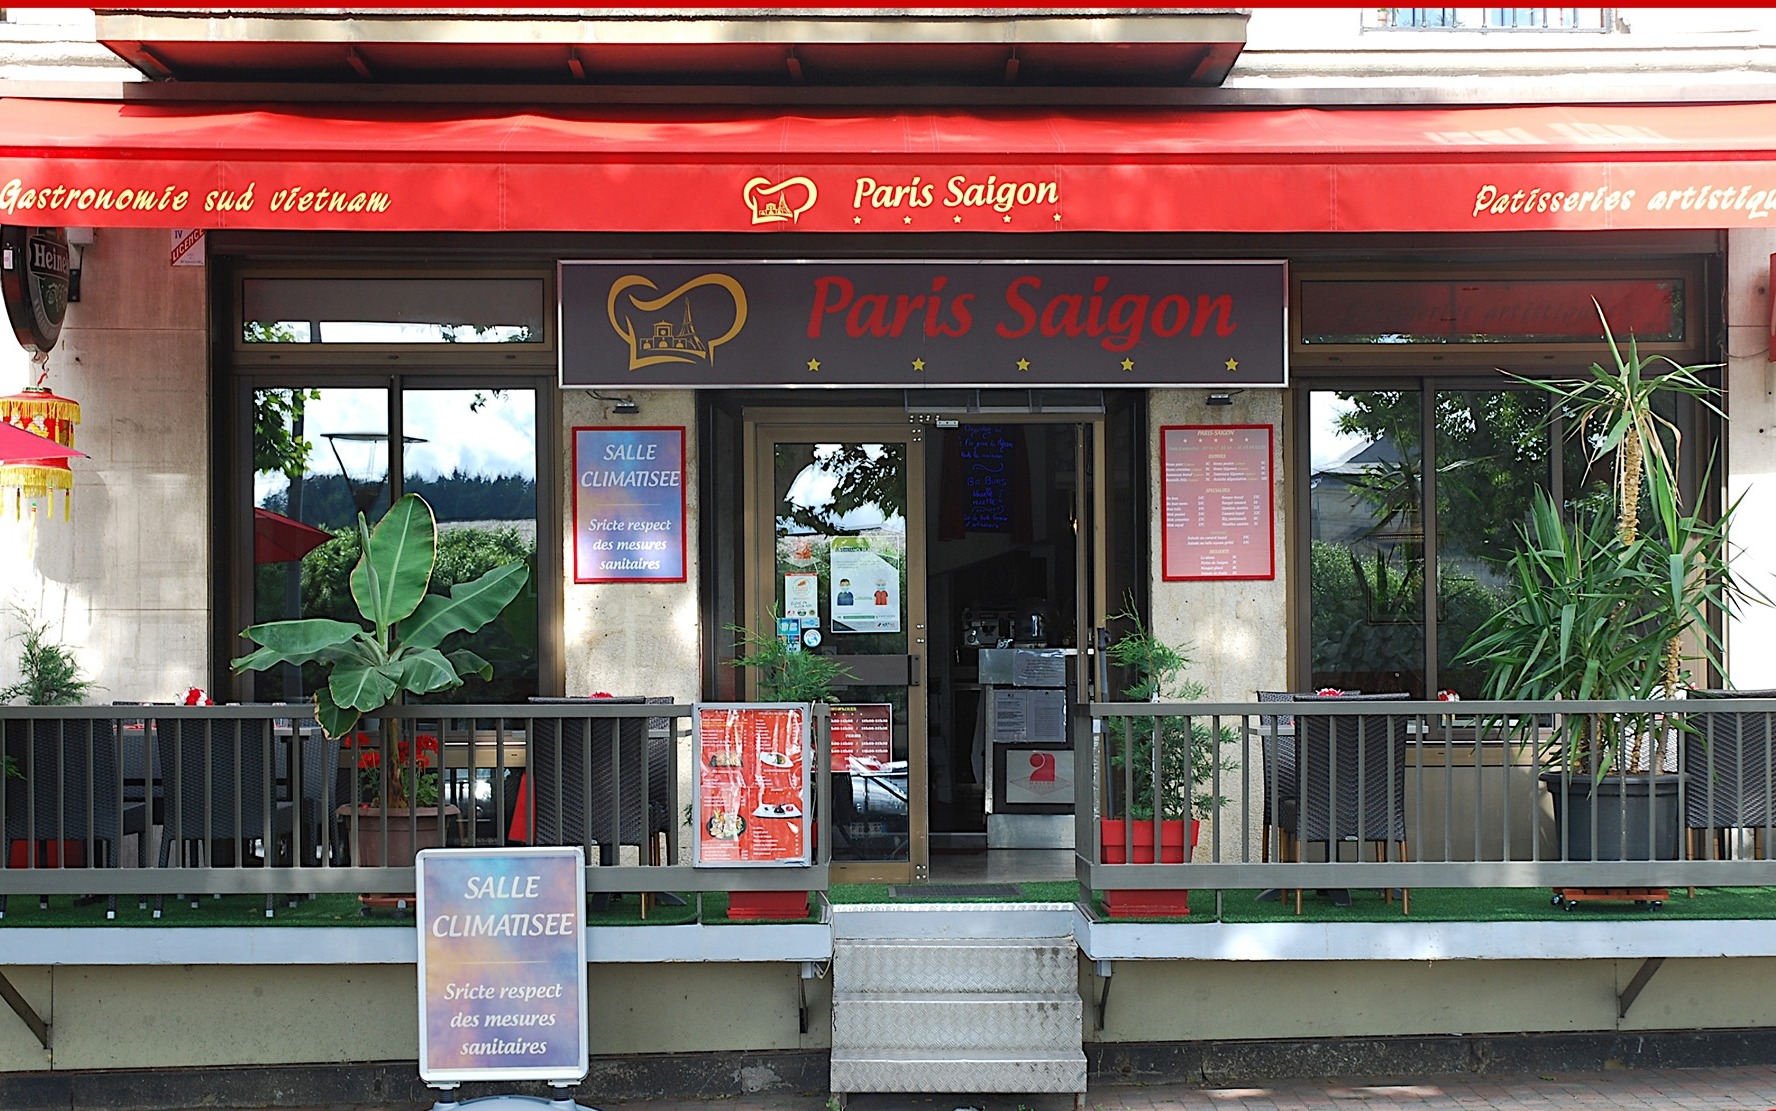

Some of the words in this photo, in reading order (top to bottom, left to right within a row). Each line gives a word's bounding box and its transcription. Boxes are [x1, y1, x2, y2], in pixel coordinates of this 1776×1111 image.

[0, 179, 189, 214] Gastronomie
[204, 181, 255, 212] sud
[269, 186, 391, 214] vietnam
[853, 176, 934, 208] Paris
[943, 175, 1059, 212] Saigon
[1472, 184, 1636, 217] Patisseries
[34, 243, 68, 274] Heine
[806, 275, 975, 338] Paris
[996, 275, 1238, 353] Saigon
[603, 444, 657, 461] SALLE
[581, 470, 681, 487] CLIMATISEE
[588, 519, 624, 531] Sricte
[627, 519, 672, 533] respect
[592, 539, 613, 550] des
[616, 540, 667, 551] mesures
[599, 557, 661, 570] sanitaires
[464, 875, 541, 900] SALLE
[432, 912, 575, 938] CLIMATISEE
[444, 983, 495, 1000] Sricte
[499, 983, 563, 1002] respect
[450, 1012, 479, 1028] des
[484, 1013, 556, 1027] mesures
[460, 1038, 547, 1055] sanitaires
